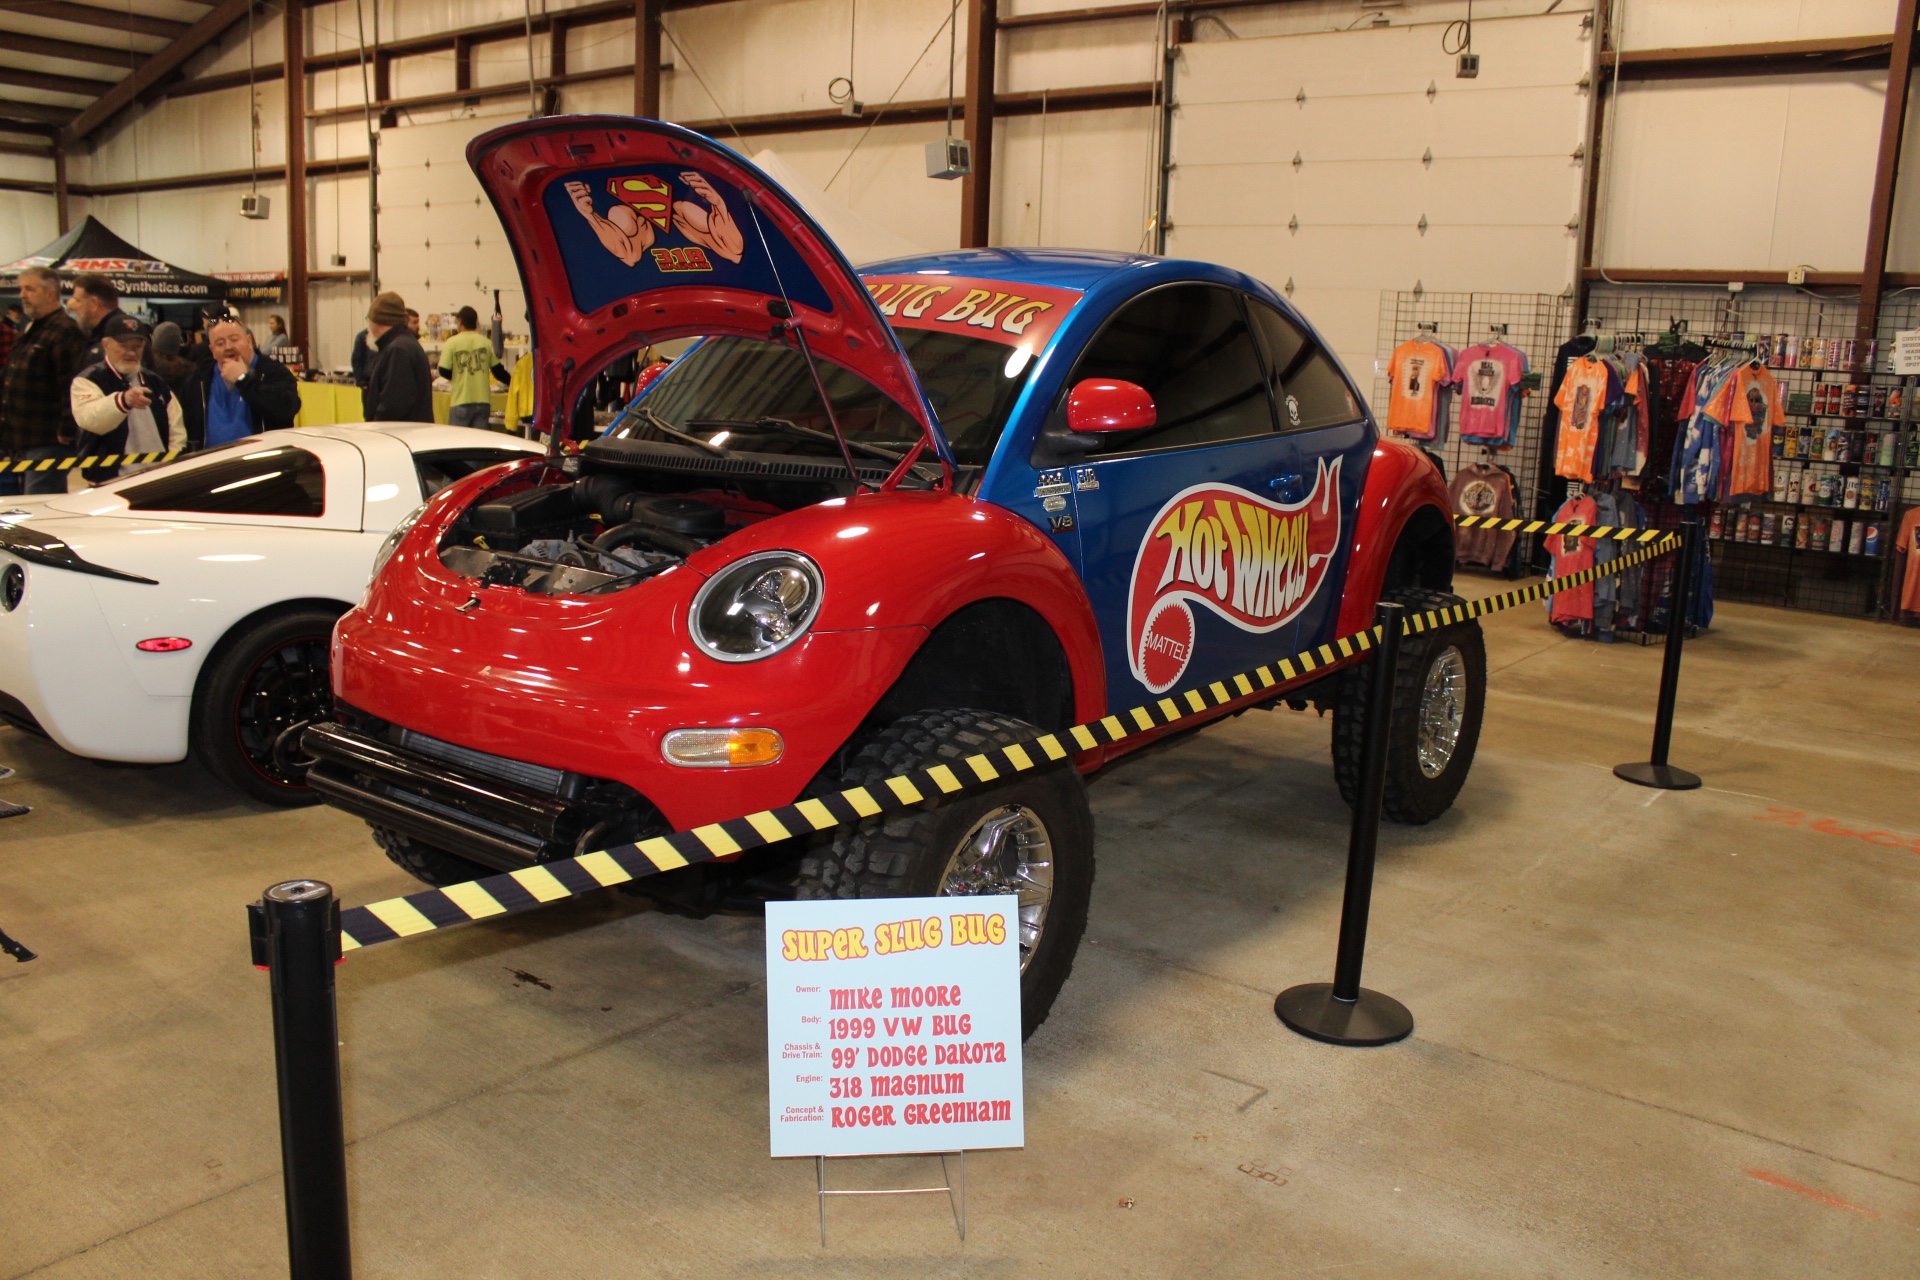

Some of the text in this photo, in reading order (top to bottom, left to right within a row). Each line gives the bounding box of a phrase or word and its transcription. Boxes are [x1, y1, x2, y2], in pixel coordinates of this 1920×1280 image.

[651, 247, 706, 264] 318
[226, 287, 249, 298] ARLEY
[935, 288, 1054, 335] BUG
[1147, 632, 1185, 662] MATTEL
[782, 914, 1006, 961] SUPER SLUG BUG
[796, 985, 821, 993] Owner:
[801, 1016, 821, 1024] Body:
[828, 1017, 875, 1039] 1999
[932, 1014, 971, 1036] BUG
[831, 1047, 860, 1069] 99'
[796, 1075, 823, 1083] Engine:
[830, 1077, 862, 1098] 318
[780, 1114, 824, 1122] Fabrication:
[786, 1106, 816, 1115] Concept
